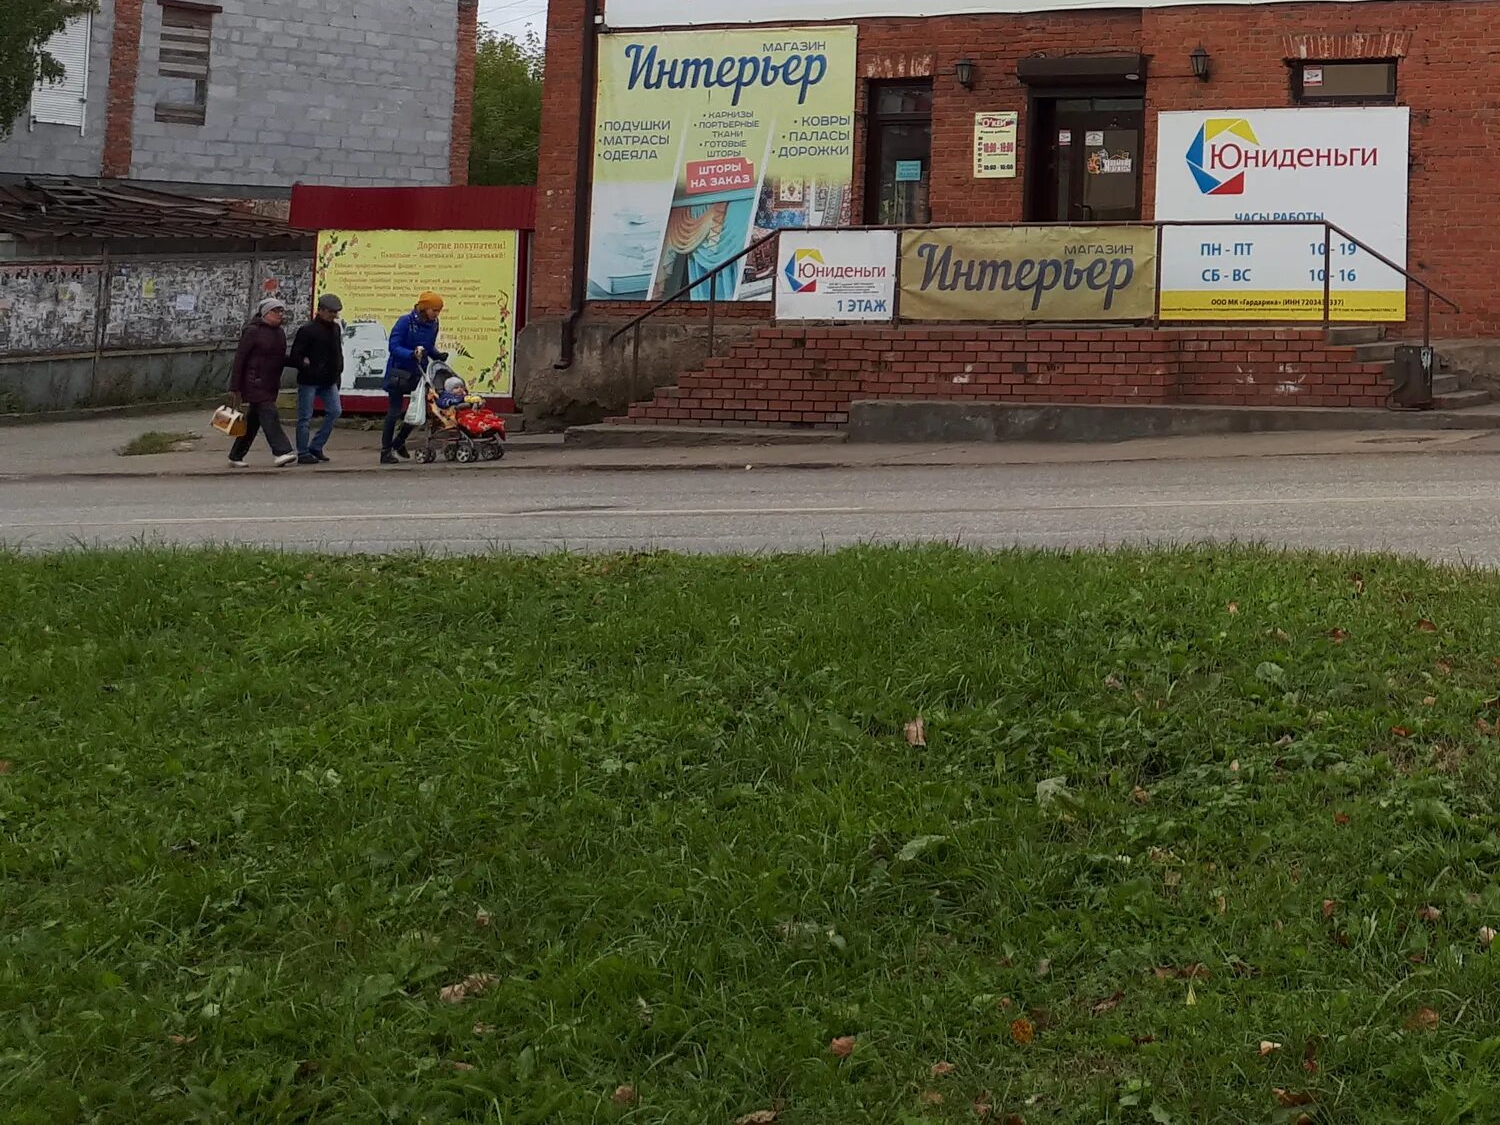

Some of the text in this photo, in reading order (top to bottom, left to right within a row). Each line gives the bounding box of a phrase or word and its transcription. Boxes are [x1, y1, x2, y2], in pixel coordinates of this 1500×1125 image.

[762, 41, 826, 53] МАГАЗИН
[624, 43, 828, 106] Интерьер
[708, 110, 754, 118] КАРНИЗЫ
[603, 120, 671, 133] ПОДУШКИ
[699, 120, 760, 129] ПОРТЬЕРНЫЕ
[801, 115, 850, 127] КОВРЫ
[603, 134, 670, 146] МАТРАСЫ
[712, 130, 743, 138] ТКАНИ
[789, 130, 850, 142] ПАЛАСЫ
[704, 140, 747, 148] ГОТОВЫЕ
[602, 149, 658, 162] ОДЕЯЛА
[707, 150, 741, 158] ШТОРЫ
[778, 145, 849, 158] ДОРОЖКИ
[1209, 143, 1378, 172] Юниденьги
[698, 163, 742, 175] ШТОРЫ
[690, 174, 751, 188] НА ЗАКАЗ
[1234, 211, 1324, 221] ЧАСЫ РАБОТЫ
[416, 240, 506, 252] Дорогие покупатели!
[1063, 244, 1134, 256] МАГАЗИН
[1200, 243, 1222, 256] ПН
[1233, 242, 1254, 256] ПТ
[1310, 242, 1326, 256] 10
[1339, 242, 1357, 256] 19
[798, 262, 887, 279] Юниденьги
[917, 242, 1135, 311] Интерьер
[1201, 269, 1220, 282] СБ
[1232, 268, 1252, 282] ВС
[1309, 268, 1326, 282] 10
[1339, 269, 1356, 282] 16
[837, 299, 887, 312] 1 ЭТАЖ
[1211, 298, 1227, 306] ООО
[1227, 298, 1239, 306] МК
[1282, 298, 1300, 307] (ИНН
